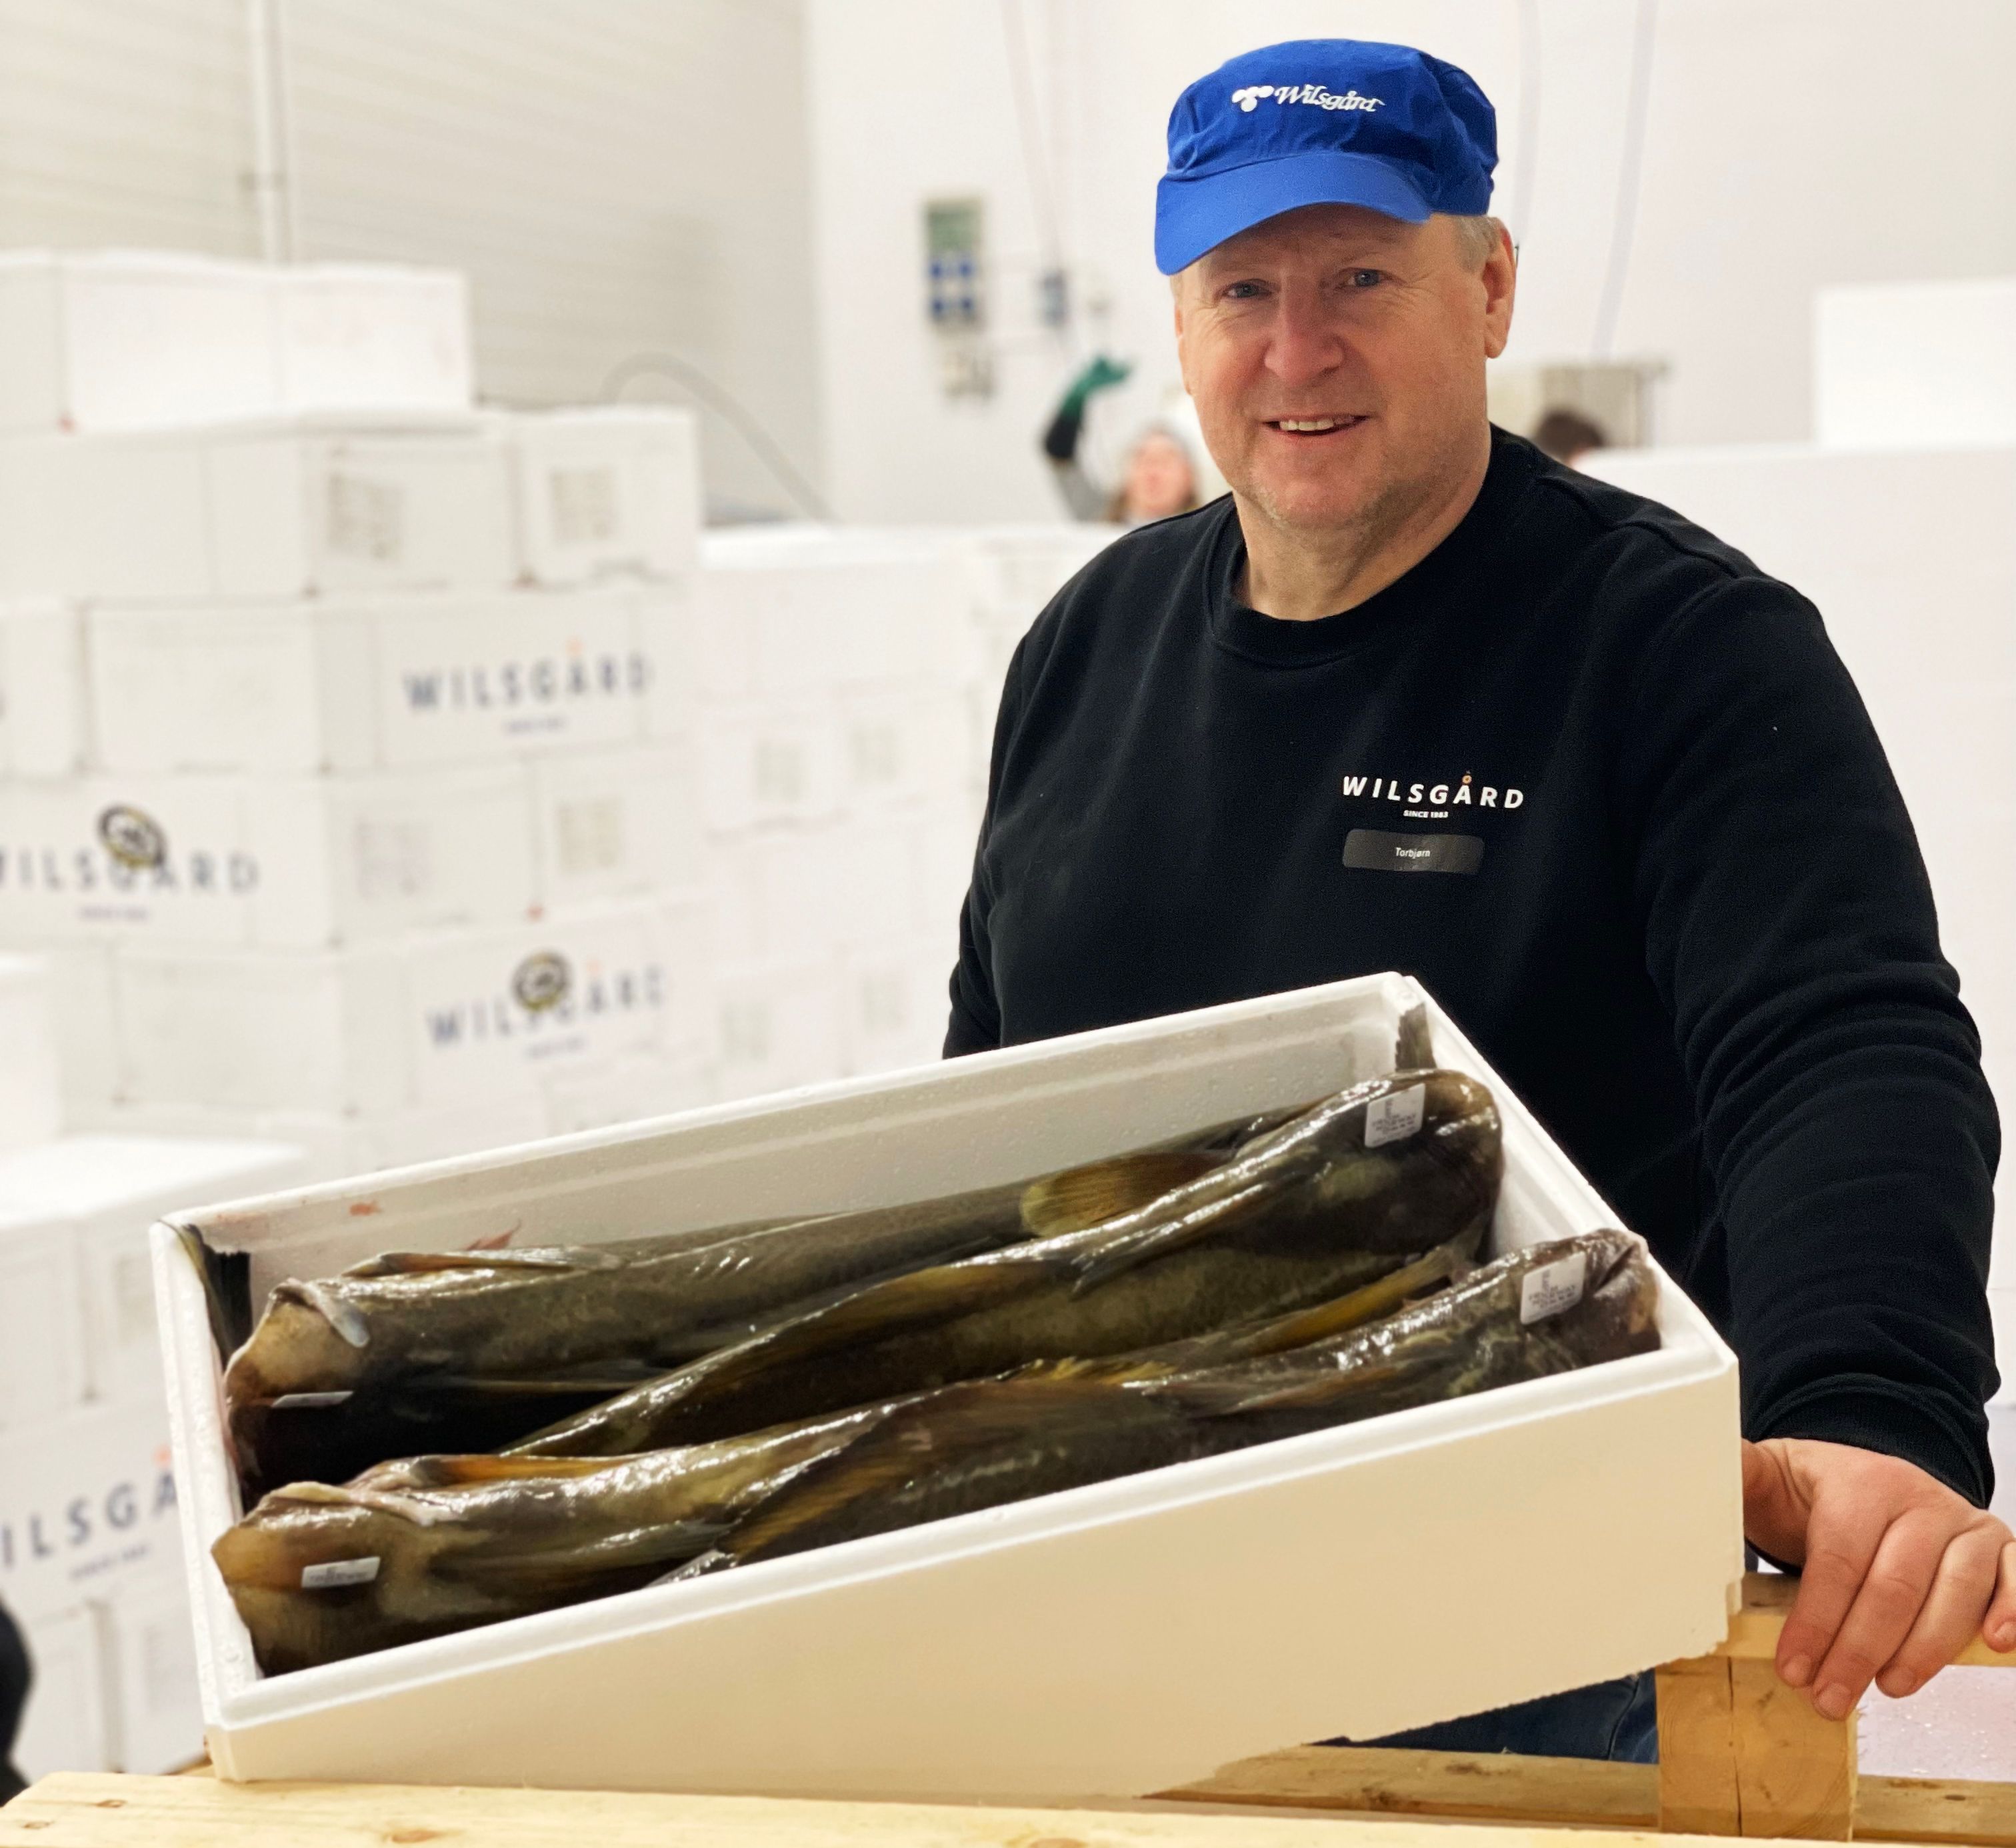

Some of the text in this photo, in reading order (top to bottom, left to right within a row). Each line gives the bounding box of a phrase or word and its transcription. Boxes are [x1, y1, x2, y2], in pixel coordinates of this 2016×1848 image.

[1274, 84, 1385, 112] Wilsgård
[401, 637, 653, 711] WILSGÅRD
[1343, 775, 1524, 809] WILSGÅRD
[1403, 809, 1429, 818] SINCE
[1395, 847, 1431, 859] Torbjørn
